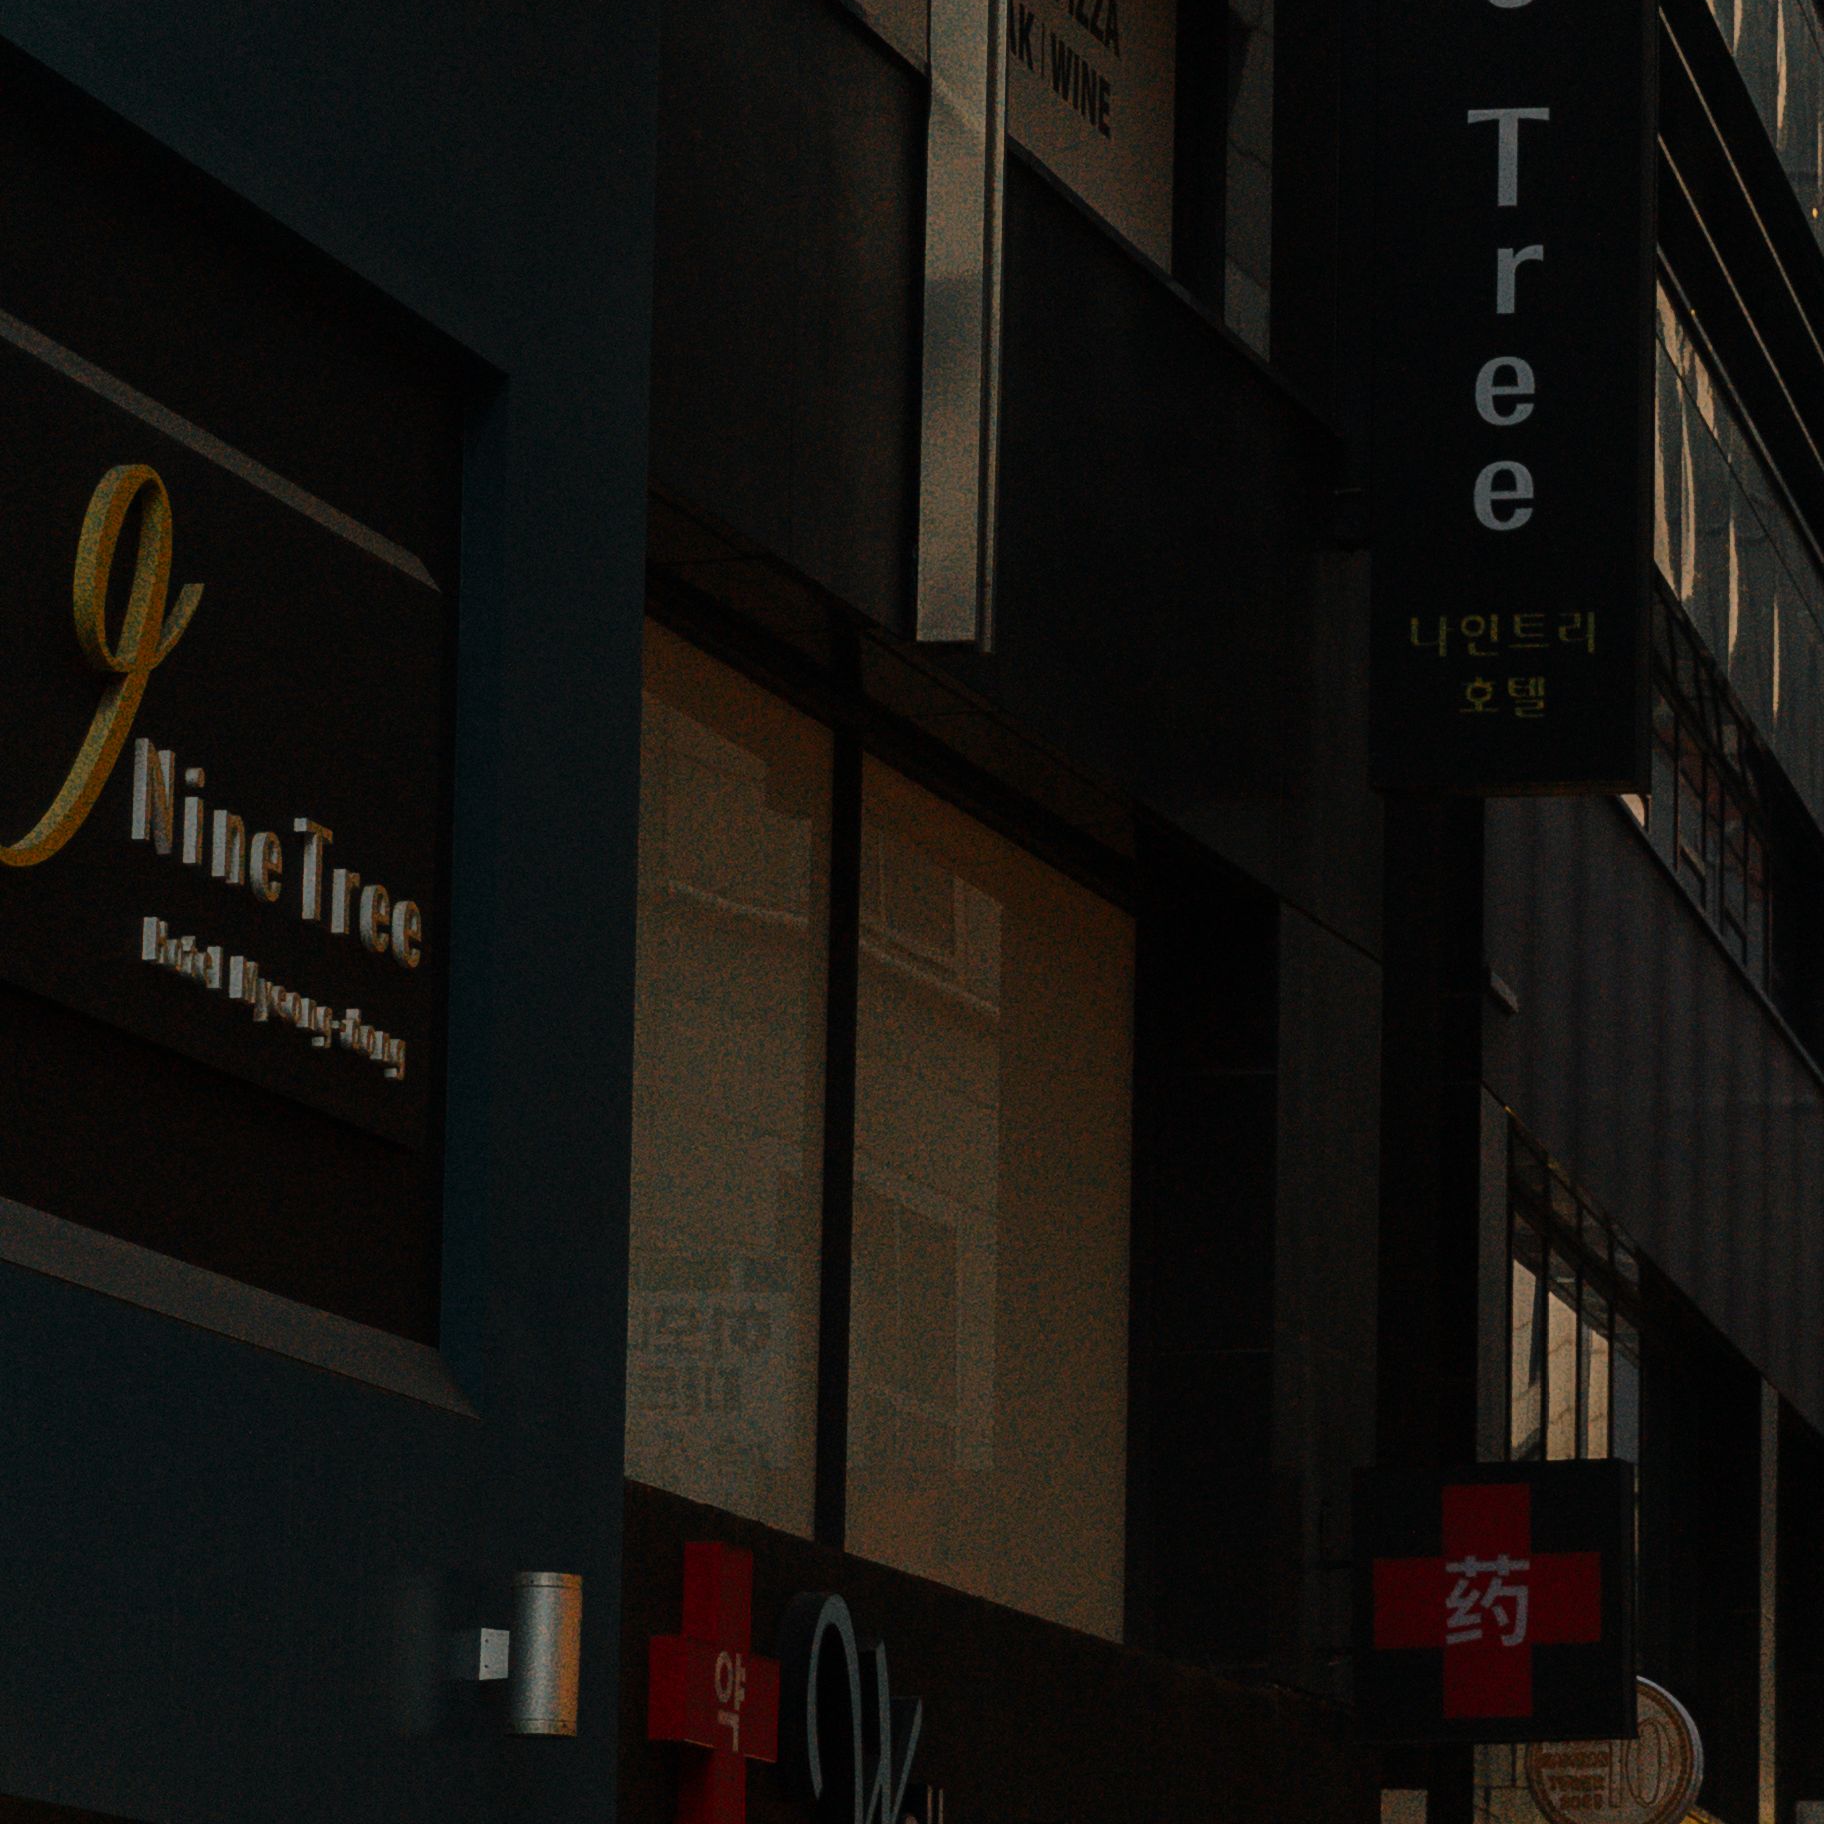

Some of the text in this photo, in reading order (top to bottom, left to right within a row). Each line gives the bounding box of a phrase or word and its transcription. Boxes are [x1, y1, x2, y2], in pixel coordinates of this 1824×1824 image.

[1051, 30, 1112, 140] WINE
[1466, 106, 1552, 534] Tree
[1408, 609, 1598, 658] 나인트리
[1455, 674, 1549, 720] 호텔
[130, 736, 424, 970] Nine Tree
[140, 915, 407, 1081] Hotel Myeong-dong
[1444, 1552, 1532, 1648] 药
[713, 1649, 748, 1754] 약
